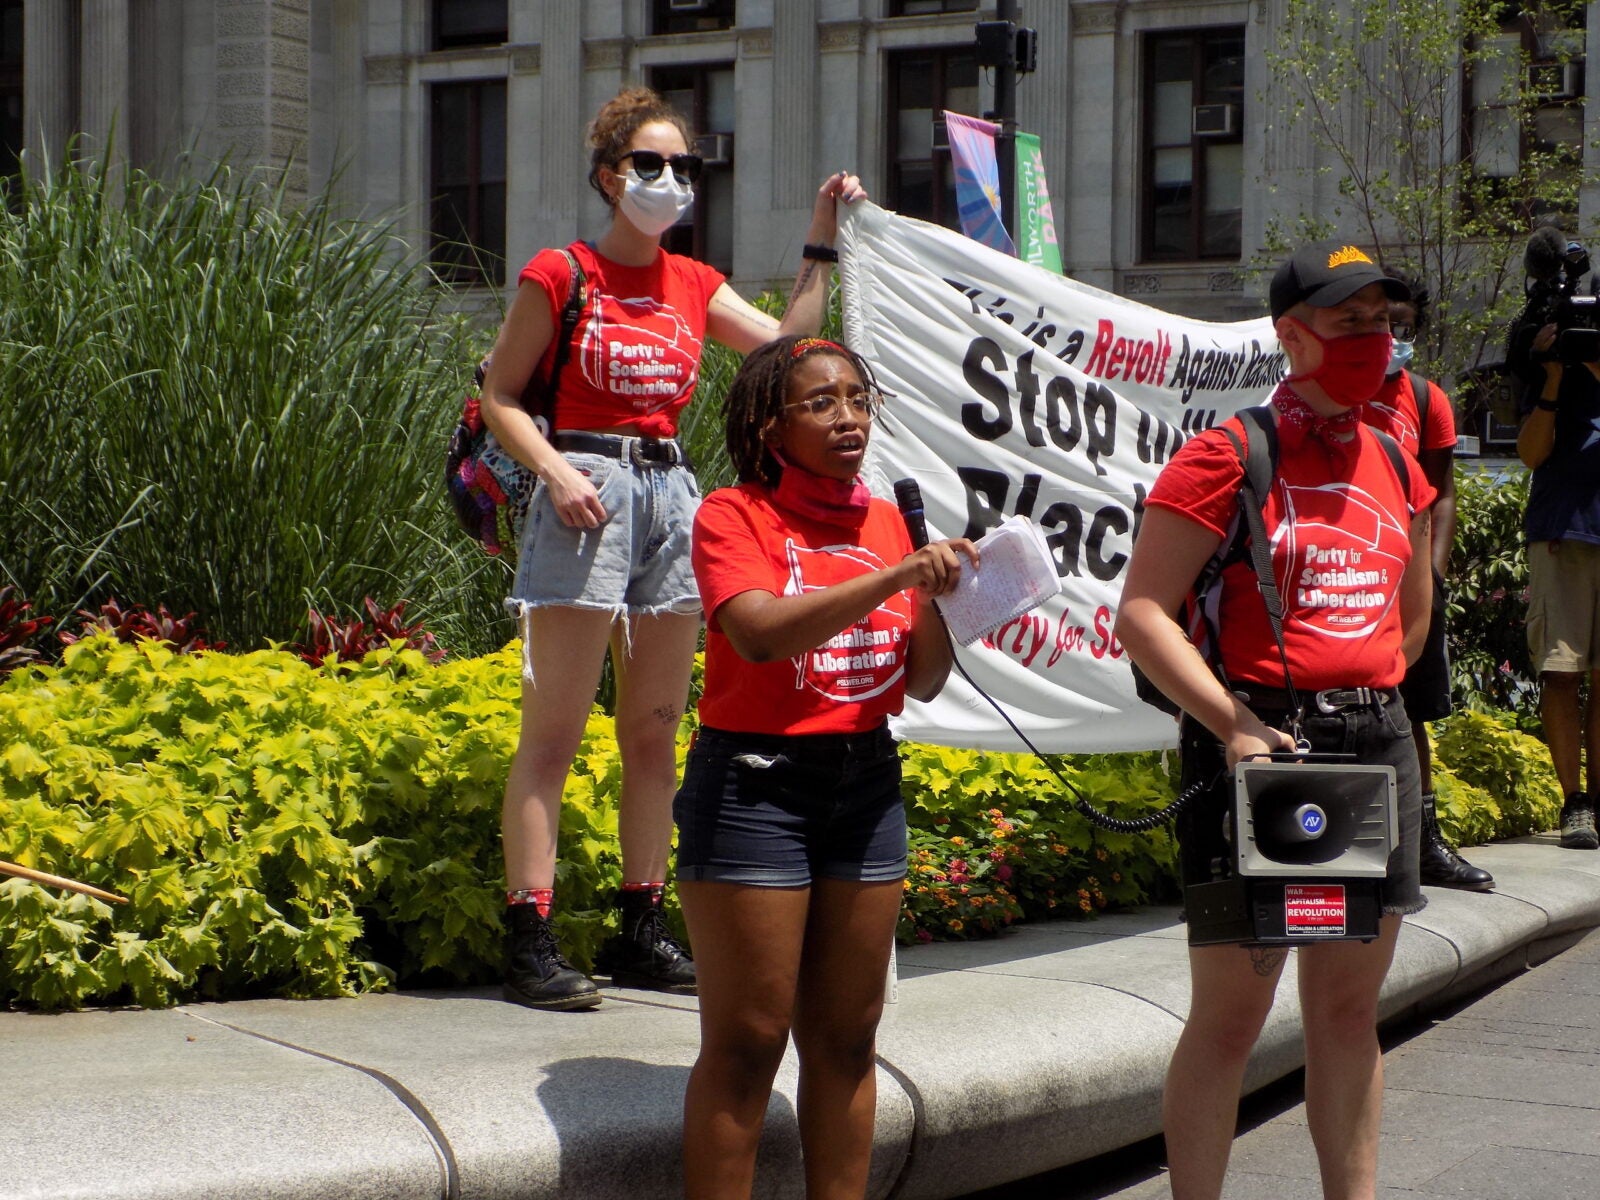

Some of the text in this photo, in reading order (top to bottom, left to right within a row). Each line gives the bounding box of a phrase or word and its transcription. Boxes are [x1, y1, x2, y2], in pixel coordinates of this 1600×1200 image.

[609, 341, 665, 359] Party for
[609, 360, 676, 377] Socialism
[1083, 318, 1172, 387] Revolt
[1169, 333, 1246, 404] Against
[609, 379, 678, 395] Liberation
[961, 336, 1118, 476] Stop
[957, 466, 1147, 582] Blac
[1305, 544, 1362, 566] Party for
[1300, 567, 1388, 587] Socialism &
[1298, 588, 1385, 608] Liberation
[892, 626, 901, 642] &
[980, 611, 1048, 668] rty
[1047, 608, 1084, 668] for
[813, 651, 897, 672] Liberation
[1288, 908, 1344, 917] REVOLUTION
